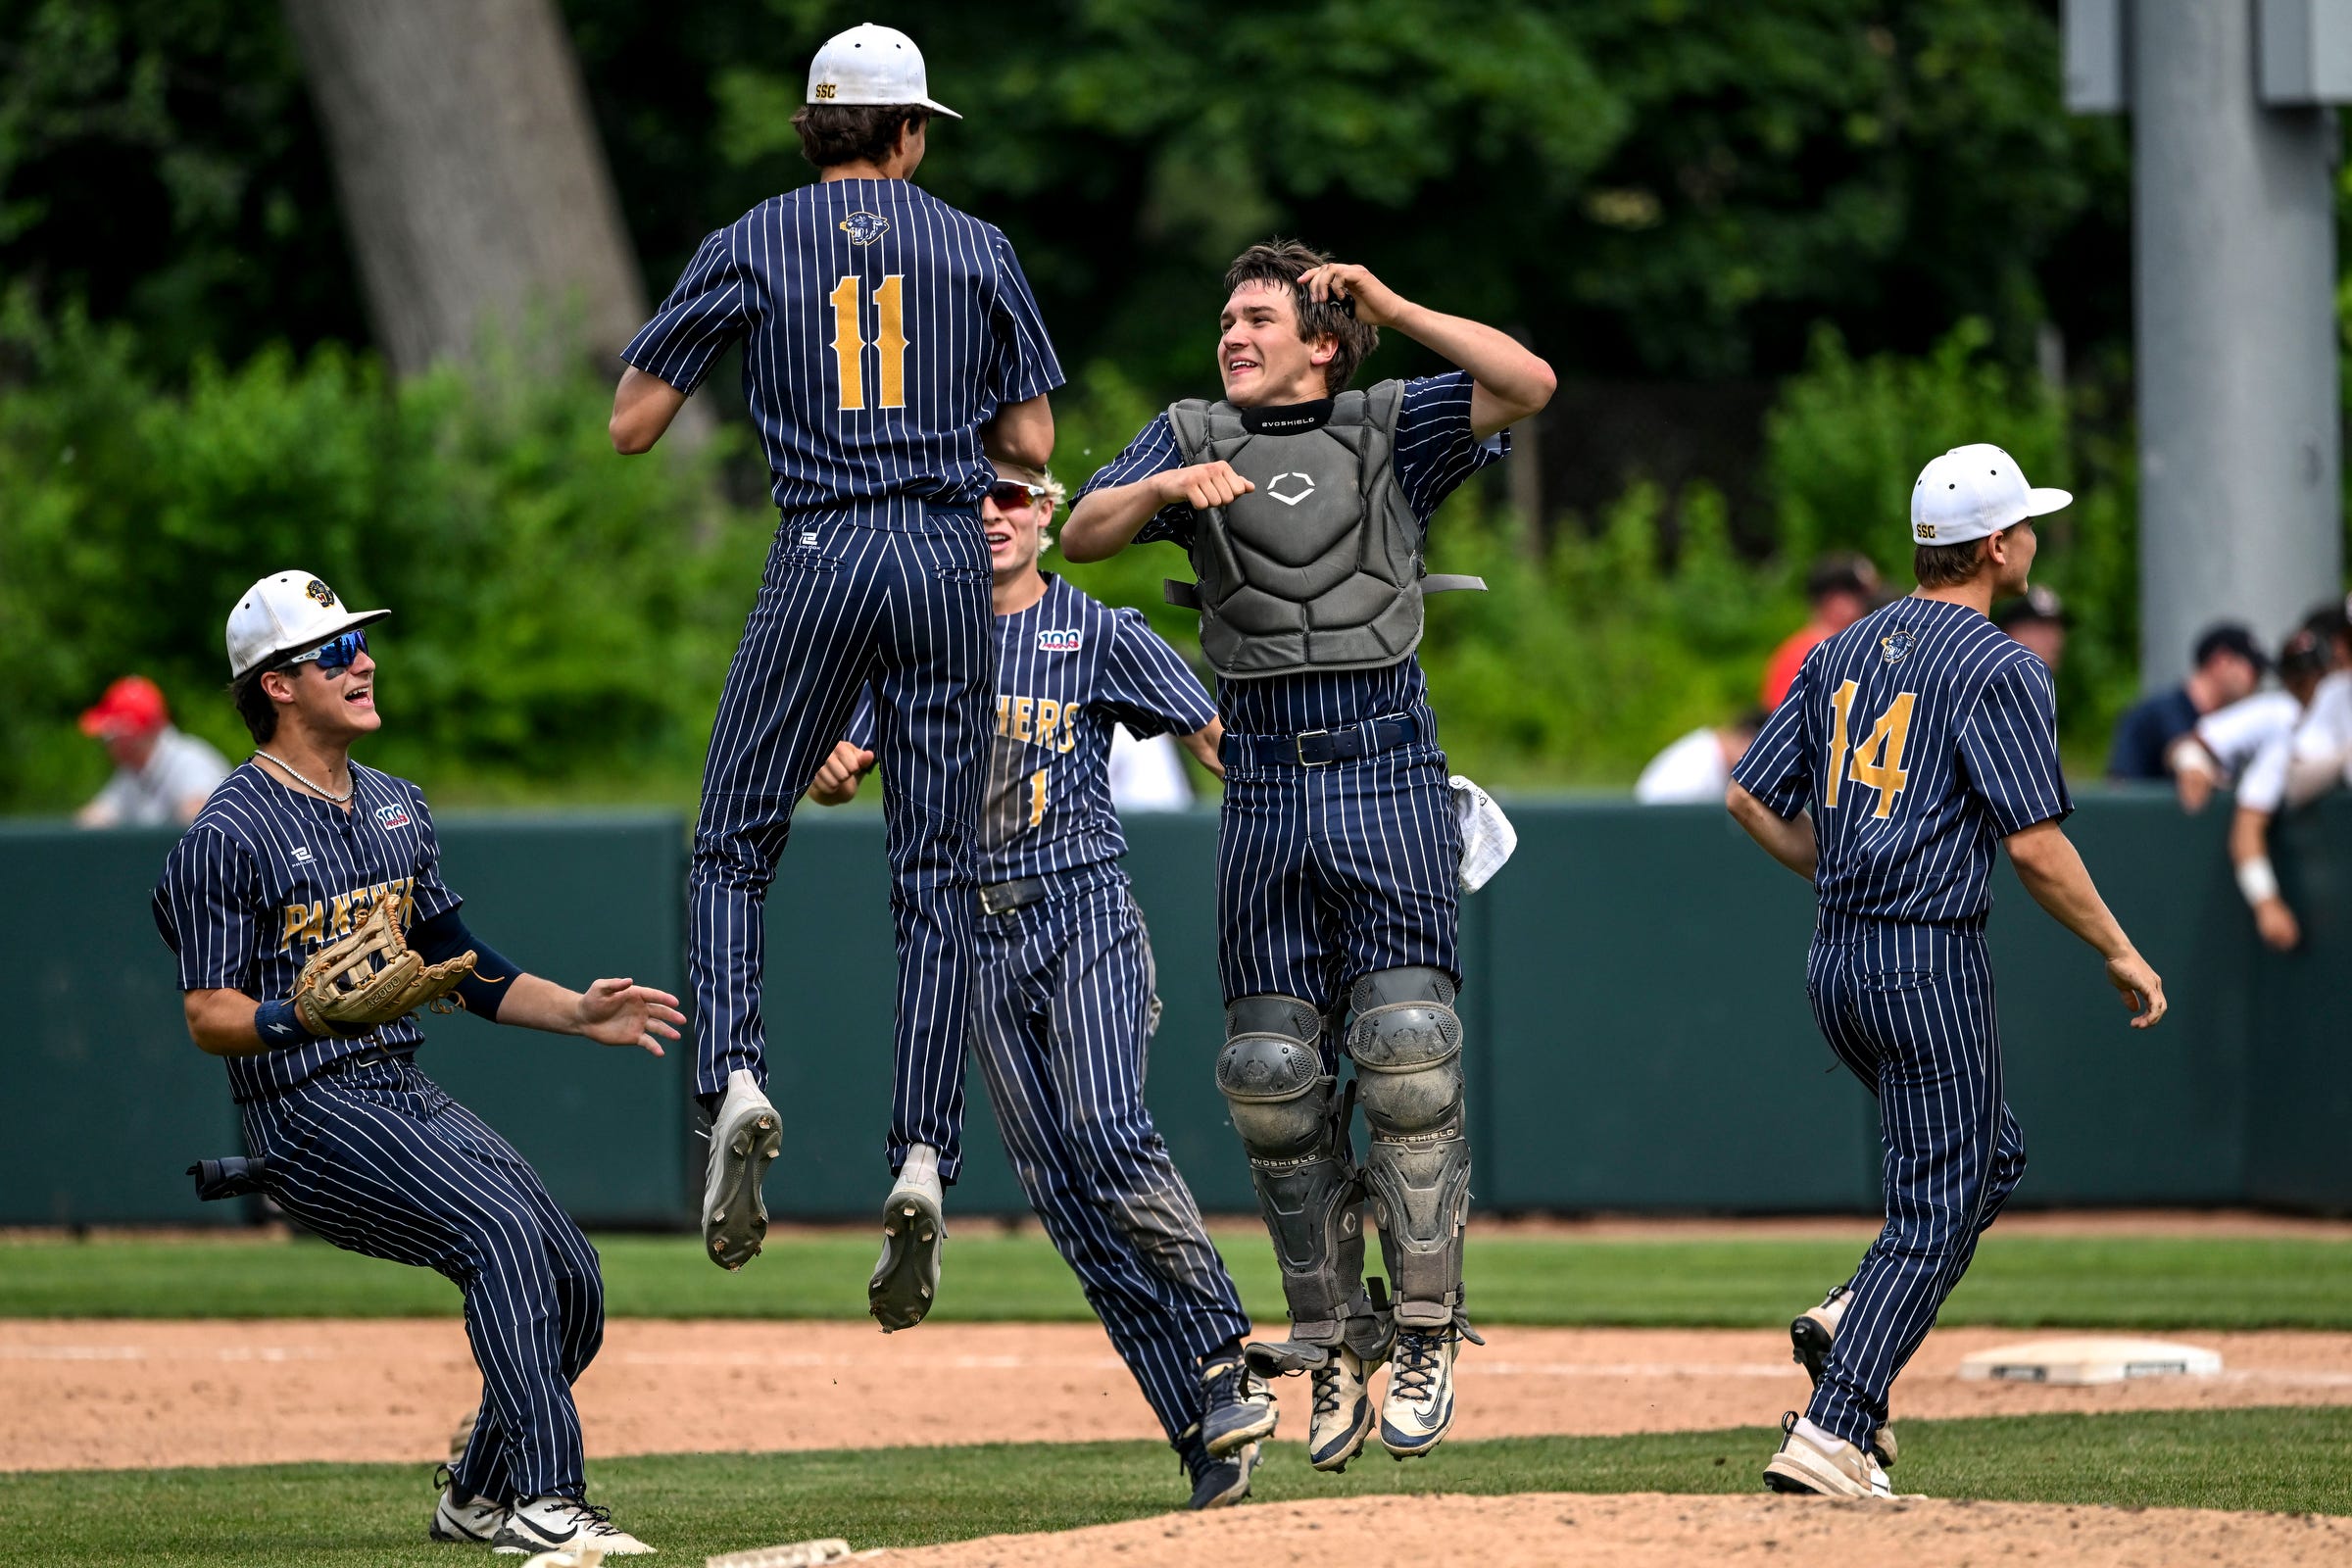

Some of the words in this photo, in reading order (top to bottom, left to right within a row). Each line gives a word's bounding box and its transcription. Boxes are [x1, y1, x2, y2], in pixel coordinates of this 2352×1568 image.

[815, 83, 836, 99] SSC
[829, 274, 910, 411] 11
[1261, 416, 1315, 428] EVOSHIELD
[1916, 523, 1936, 539] SSC
[1825, 679, 1918, 819] 14
[1028, 768, 1049, 827] 1
[367, 976, 401, 1008] A2000
[1382, 1129, 1454, 1143] EVOSHIELD
[1250, 1154, 1316, 1166] EVOSHIELD
